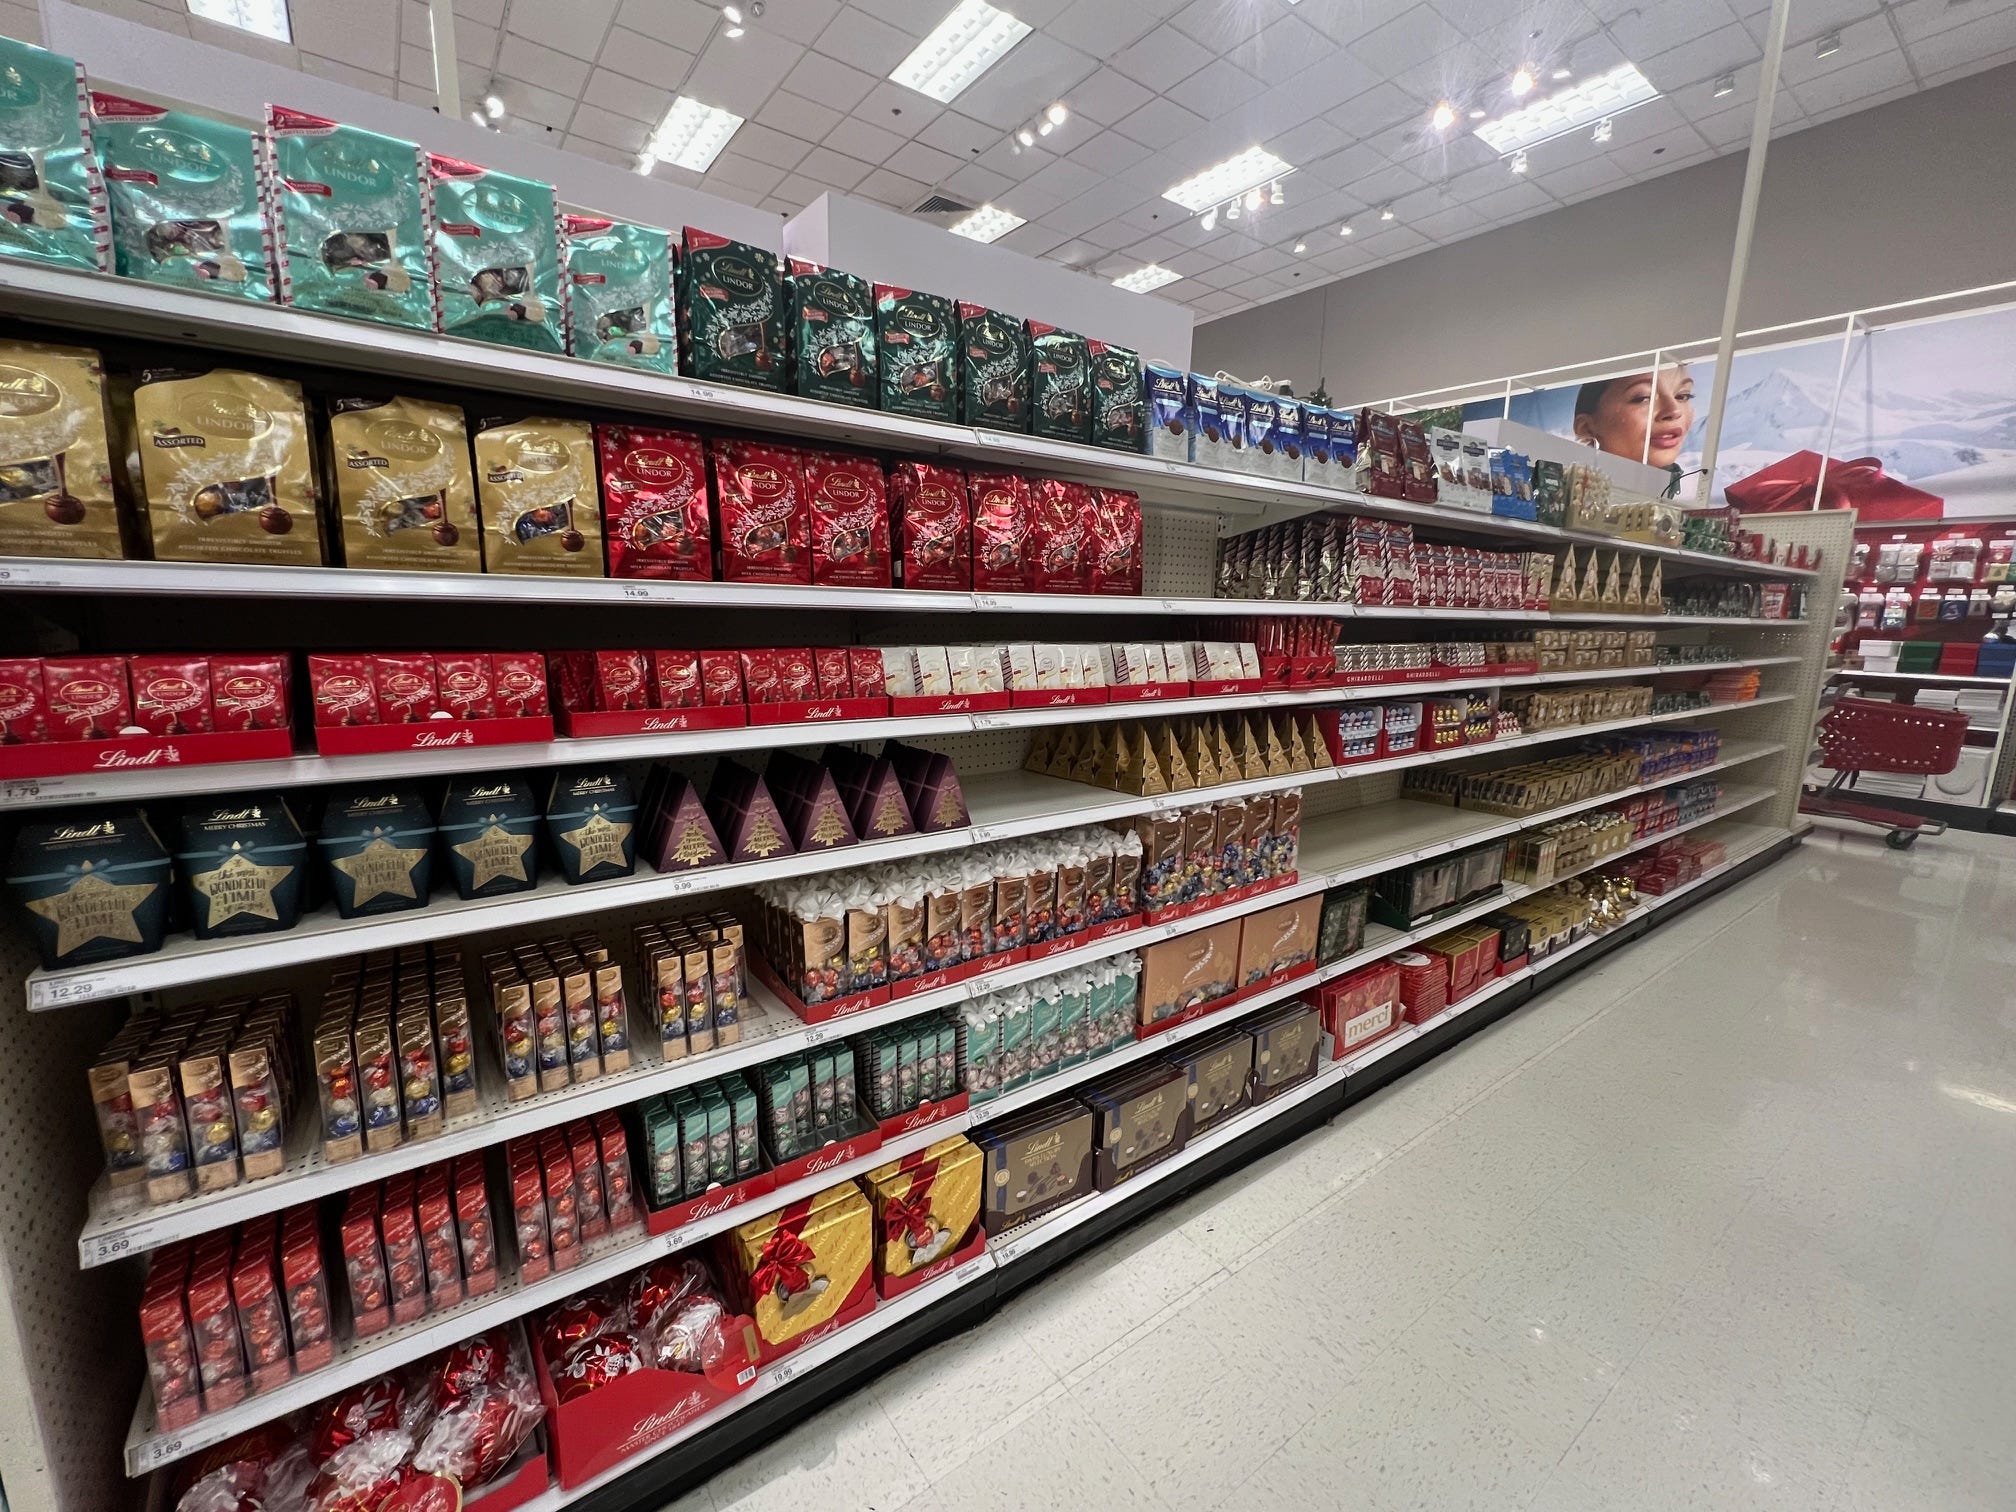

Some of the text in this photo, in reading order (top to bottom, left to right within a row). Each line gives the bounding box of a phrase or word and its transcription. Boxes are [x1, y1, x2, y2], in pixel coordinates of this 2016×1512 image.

[276, 114, 284, 128] 2
[324, 166, 376, 188] LINDOR
[722, 261, 749, 277] Lindt
[722, 275, 754, 291] LINDOR
[822, 297, 850, 311] LINDOR
[906, 309, 926, 321] Lindt
[904, 320, 932, 332] LINDOR
[982, 339, 1004, 349] LINDOR
[1053, 353, 1073, 363] LINDOR
[142, 370, 152, 383] 5
[1154, 378, 1176, 392] Lindt
[690, 388, 714, 398] 14.99
[337, 399, 344, 411] 5
[1251, 402, 1269, 415] Lindt
[197, 416, 256, 432] LINDOR
[1309, 415, 1324, 425] Lindt
[1332, 421, 1347, 431] Lindt
[156, 437, 204, 447] ASSORTED
[381, 441, 428, 455] LINDOR
[349, 458, 388, 468] ASSORTED
[636, 454, 664, 466] Lindt
[636, 468, 672, 478] LINDOR
[831, 476, 853, 487] Lindt
[832, 488, 860, 498] LINDOR
[919, 488, 941, 497] Lindt
[921, 498, 946, 507] LINDOR
[178, 544, 220, 552] ASSORTED
[220, 545, 266, 554] CHOCOLATE
[1346, 674, 1384, 682] GHIRARDELLI
[1406, 671, 1440, 679] GHIRARDELLI
[70, 683, 96, 694] Lindt
[155, 681, 182, 691] Lindt
[232, 680, 255, 690] Lindt
[1049, 694, 1071, 705] Lindt
[1140, 688, 1156, 698] Lindt
[938, 699, 964, 711] Lindt
[805, 707, 835, 719] Lindt
[641, 717, 678, 731] Lindt
[411, 731, 462, 747] Lindt
[93, 749, 162, 768] Lindt
[574, 778, 603, 788] Lindt
[6, 787, 40, 797] 1.79
[468, 786, 503, 798] Lindt
[350, 796, 388, 809] Lindt
[208, 808, 251, 822] Lindt
[49, 824, 102, 841] Lindt
[204, 821, 267, 831] MERRY CHRISTMAS
[580, 832, 619, 849] WONDERFUL
[588, 844, 612, 856] TIME
[209, 878, 266, 896] WONDERFUL
[674, 882, 692, 891] 9.99
[222, 890, 256, 905] TIME
[1221, 892, 1237, 903] Lindt
[1190, 901, 1206, 912] Lindt
[1158, 910, 1176, 921] Lindt
[1103, 922, 1123, 936] Lindt
[1048, 941, 1069, 955] Lindt
[981, 955, 1005, 972] Lindt
[912, 976, 940, 992] Lindt
[975, 983, 991, 992] 12.29
[50, 983, 93, 999] 12.29
[832, 1001, 862, 1018] Lindt
[1181, 1009, 1198, 1023] Lindt
[1348, 1005, 1391, 1039] merci
[805, 1033, 824, 1043] 12.29
[1135, 1096, 1158, 1114] Lindt
[902, 1108, 939, 1132] Lindt
[1025, 1136, 1054, 1155] Lindt
[803, 1152, 844, 1177] Lindt
[685, 1193, 734, 1223] Lindt
[98, 1239, 130, 1257] 3.69
[666, 1236, 684, 1249] 3.69
[920, 1261, 948, 1281] Lindt
[801, 1323, 832, 1346] Lindt
[774, 1368, 793, 1384] 19.99
[627, 1398, 688, 1441] Lindt
[152, 1440, 183, 1460] 3.69
